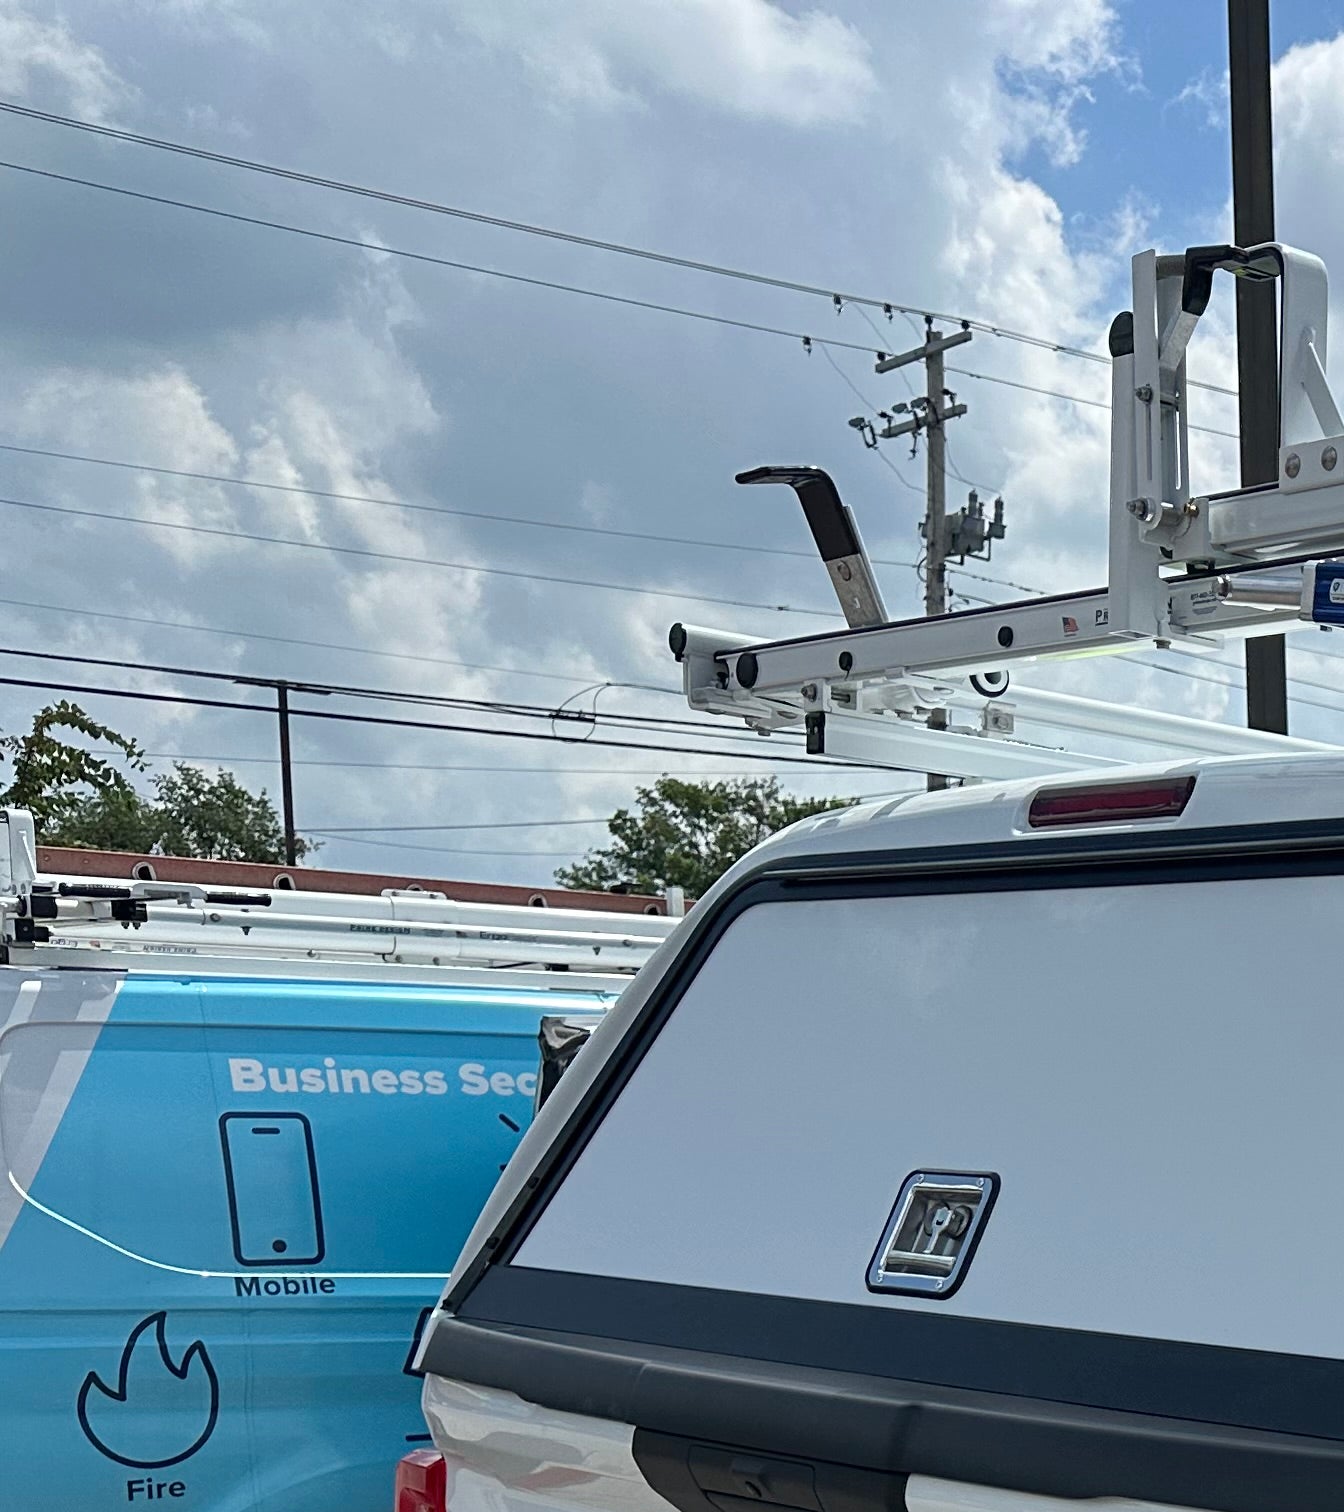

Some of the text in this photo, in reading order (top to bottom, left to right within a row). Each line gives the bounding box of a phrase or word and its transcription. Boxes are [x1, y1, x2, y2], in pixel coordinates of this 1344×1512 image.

[228, 1057, 448, 1097] Business
[234, 1275, 336, 1297] Mobile
[126, 1477, 187, 1501] Fire
